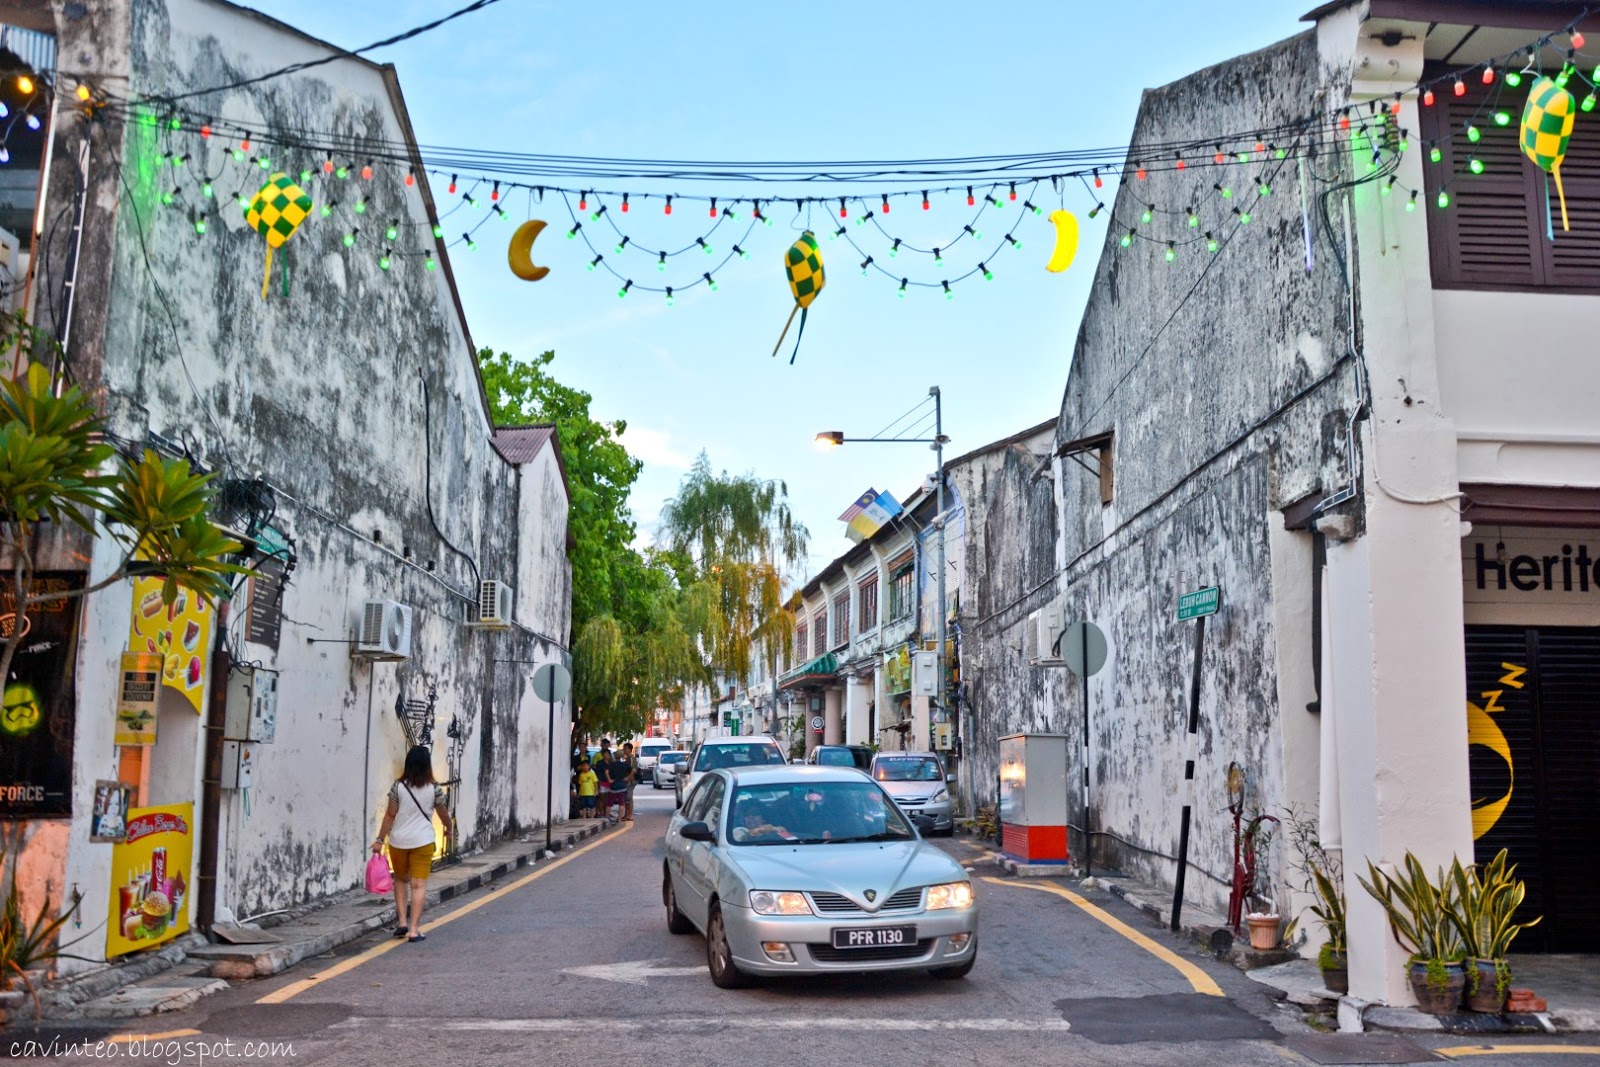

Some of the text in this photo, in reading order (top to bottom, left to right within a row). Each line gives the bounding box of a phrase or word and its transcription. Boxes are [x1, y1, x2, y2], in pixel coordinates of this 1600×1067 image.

[1475, 543, 1600, 592] Herit
[1180, 596, 1195, 609] LEBUH
[1196, 590, 1217, 605] CANNON
[0, 786, 45, 801] FORCE
[849, 929, 903, 945] PFR 1130
